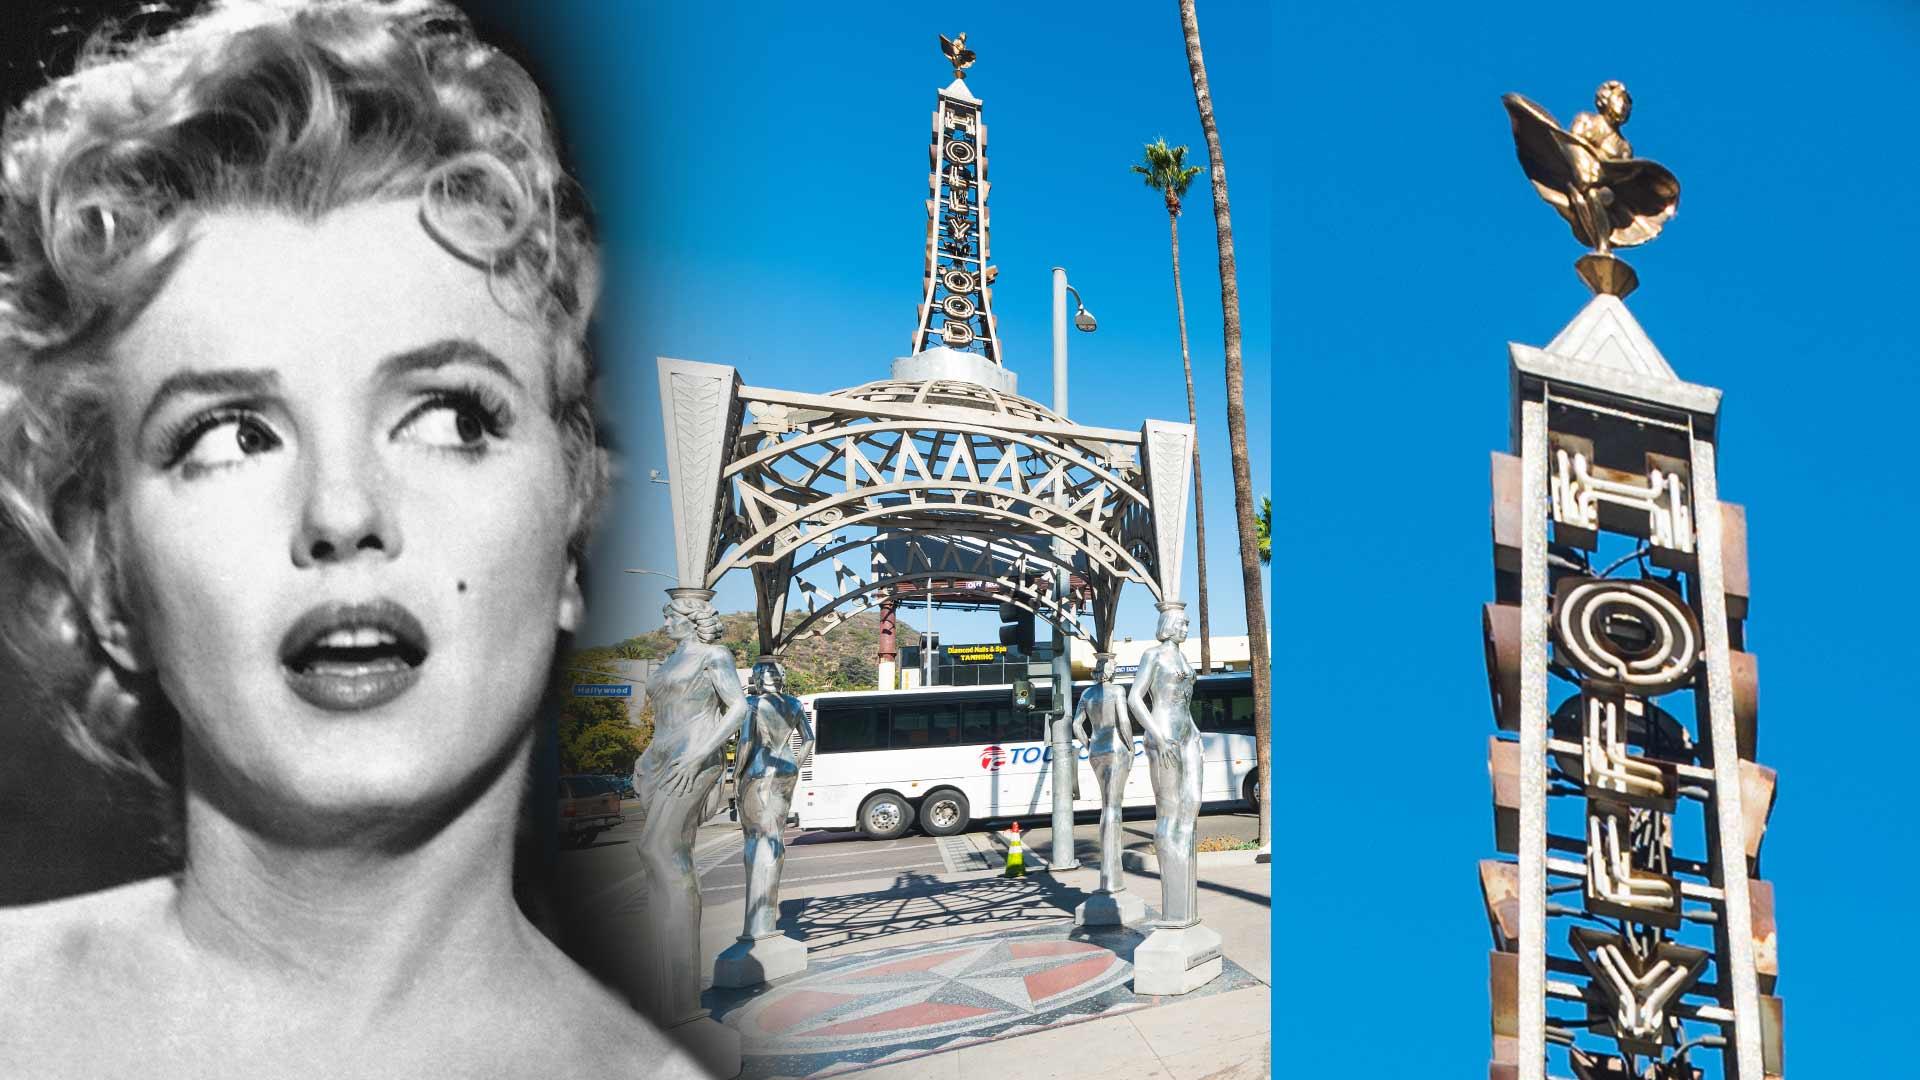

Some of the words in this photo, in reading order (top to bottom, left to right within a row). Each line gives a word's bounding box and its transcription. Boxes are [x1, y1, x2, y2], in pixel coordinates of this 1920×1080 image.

[942, 108, 977, 346] HOLLYOOD
[947, 646, 973, 654] Diamond
[995, 645, 1007, 654] Spa
[960, 653, 993, 661] TANNING
[577, 687, 628, 695] Hollywood
[1549, 432, 1708, 1080] HOLLY
